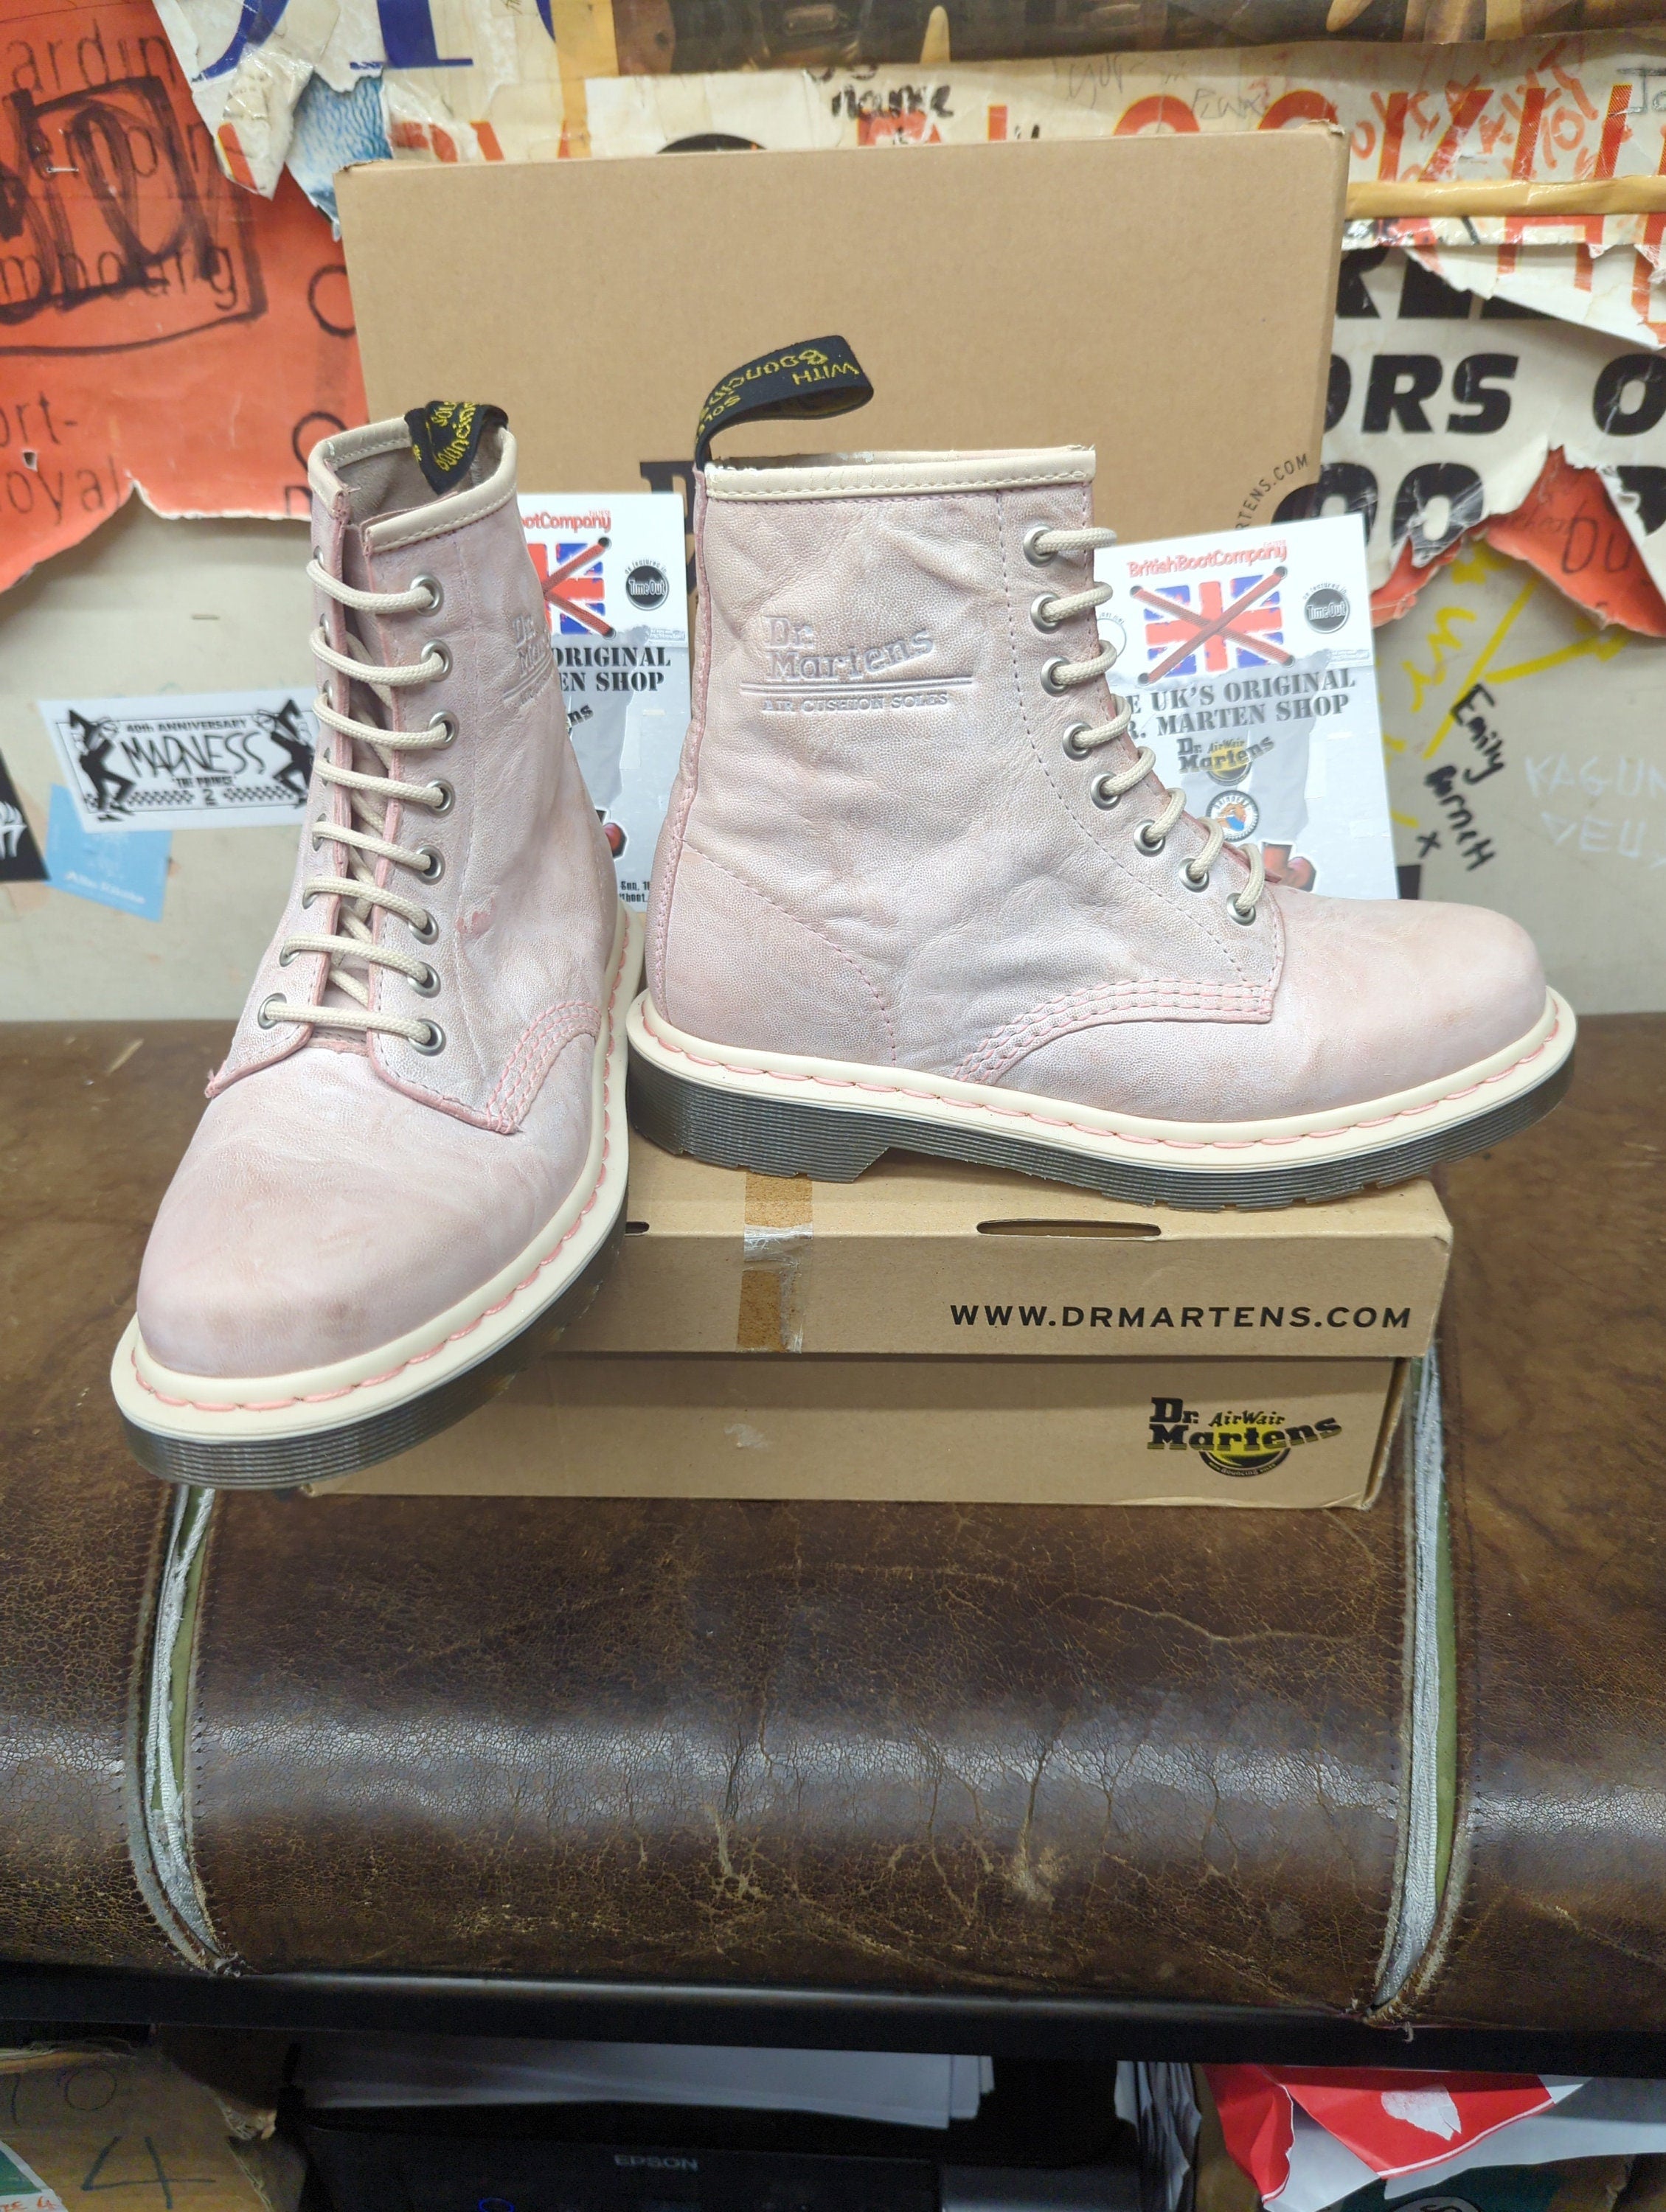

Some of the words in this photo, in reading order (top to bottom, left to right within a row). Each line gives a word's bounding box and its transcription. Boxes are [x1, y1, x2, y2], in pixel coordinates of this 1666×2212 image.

[792, 361, 860, 386] WITH
[765, 625, 937, 681] Martens
[595, 672, 665, 692] SHOP
[1224, 667, 1356, 703] ORIGINAL
[799, 695, 886, 714] CUSHION
[1156, 703, 1266, 737] MARTEN
[1276, 693, 1350, 723] SHOP
[120, 731, 265, 779] MADNESS
[1179, 736, 1274, 773] Martens
[950, 1304, 1412, 1328] WWW.DRMARTENS.COM
[1149, 1397, 1199, 1424] Dr.
[1207, 1410, 1285, 1427] AirWair
[1147, 1416, 1343, 1451] Martens
[614, 2154, 699, 2172] EPSON
